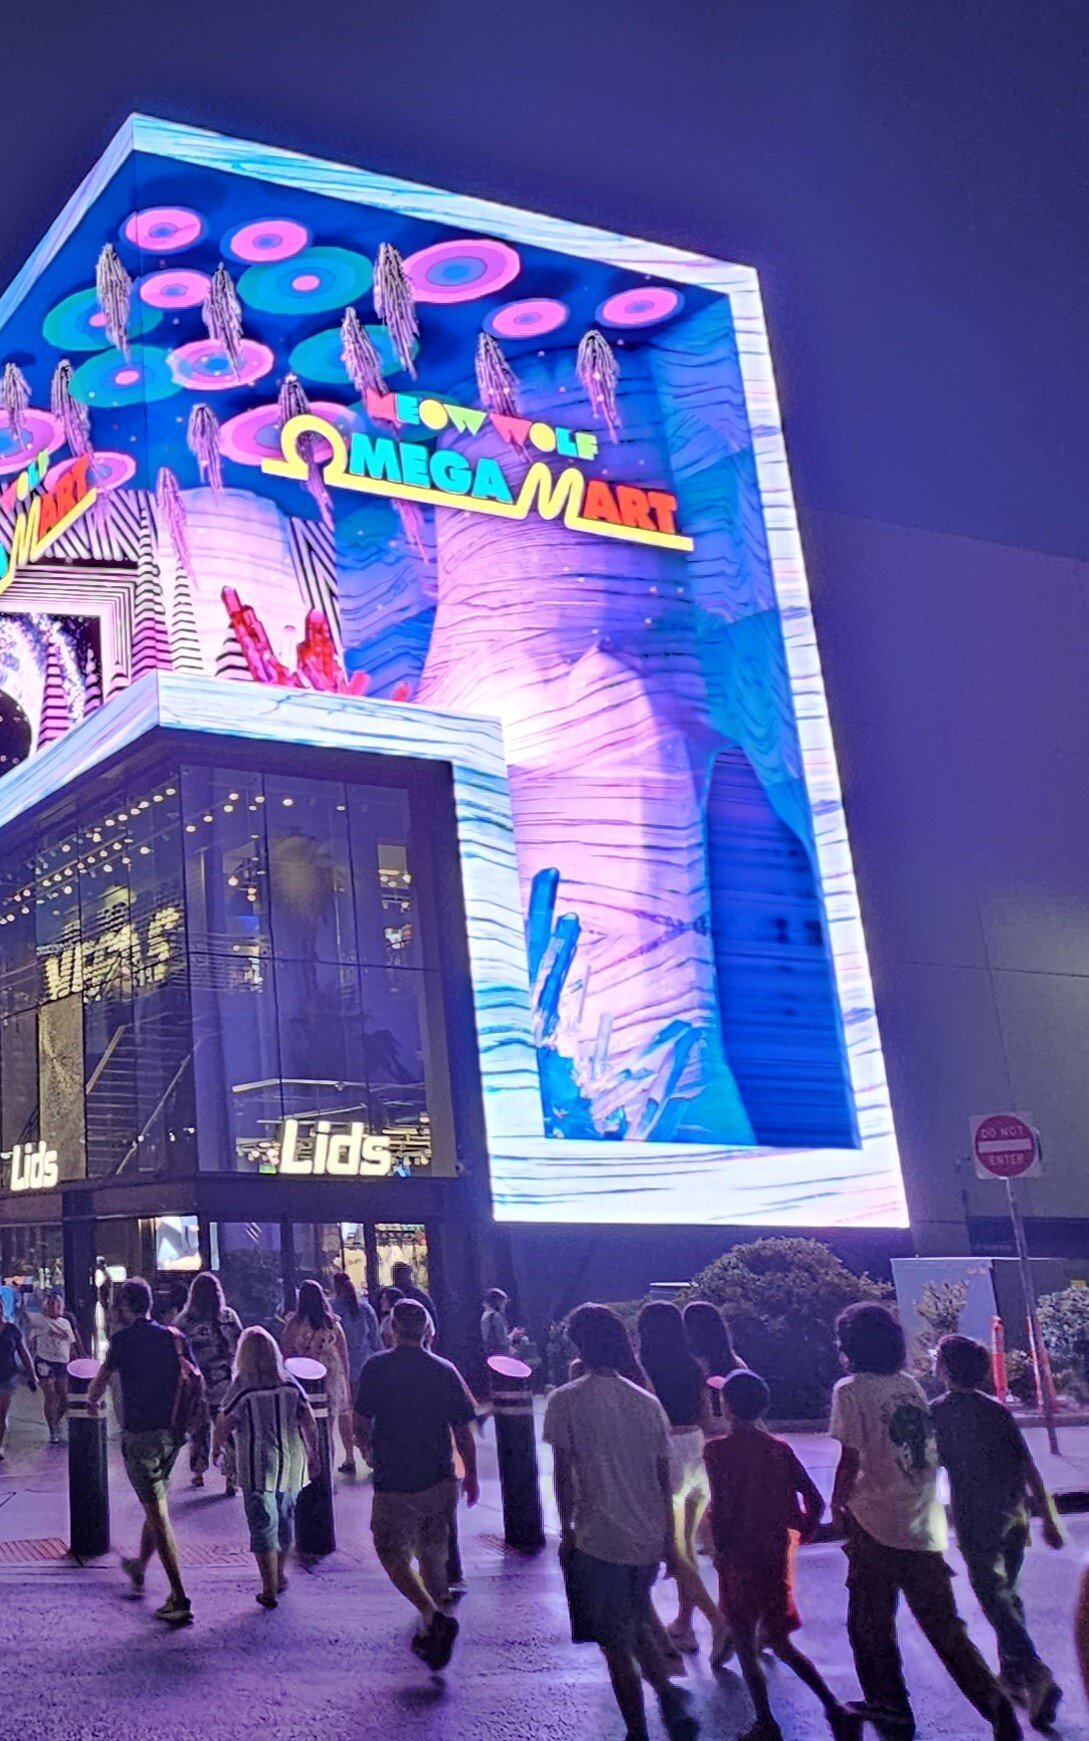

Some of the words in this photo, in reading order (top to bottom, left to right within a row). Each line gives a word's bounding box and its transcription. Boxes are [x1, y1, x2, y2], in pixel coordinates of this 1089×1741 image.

[279, 1120, 394, 1176] Lids
[981, 1128, 997, 1139] DO
[1001, 1125, 1024, 1137] NOT
[10, 1141, 59, 1192] Lids
[989, 1153, 1024, 1166] ENTER
